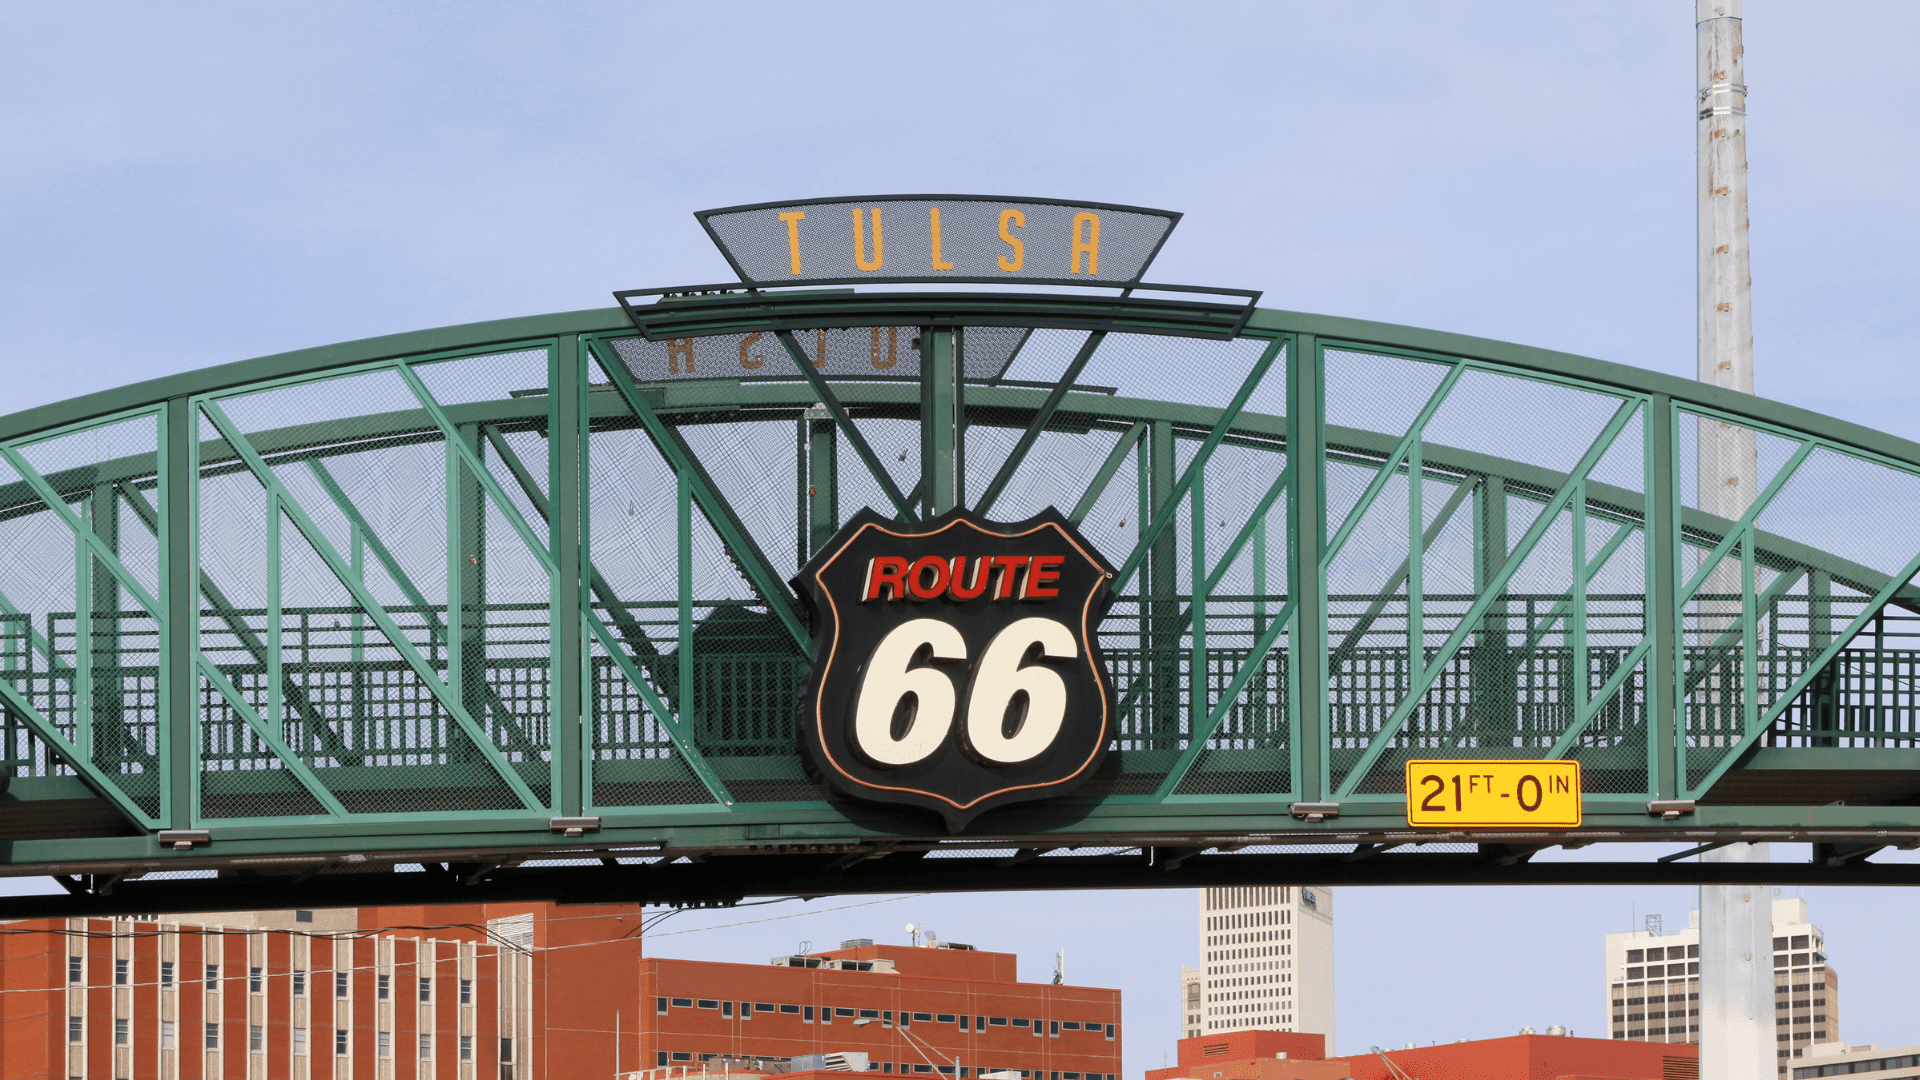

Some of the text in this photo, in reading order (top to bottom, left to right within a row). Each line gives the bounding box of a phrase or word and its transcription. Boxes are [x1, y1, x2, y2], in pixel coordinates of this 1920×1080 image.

[779, 207, 1100, 275] TULSA
[864, 555, 1065, 600] ROUTE
[855, 617, 1078, 765] 66
